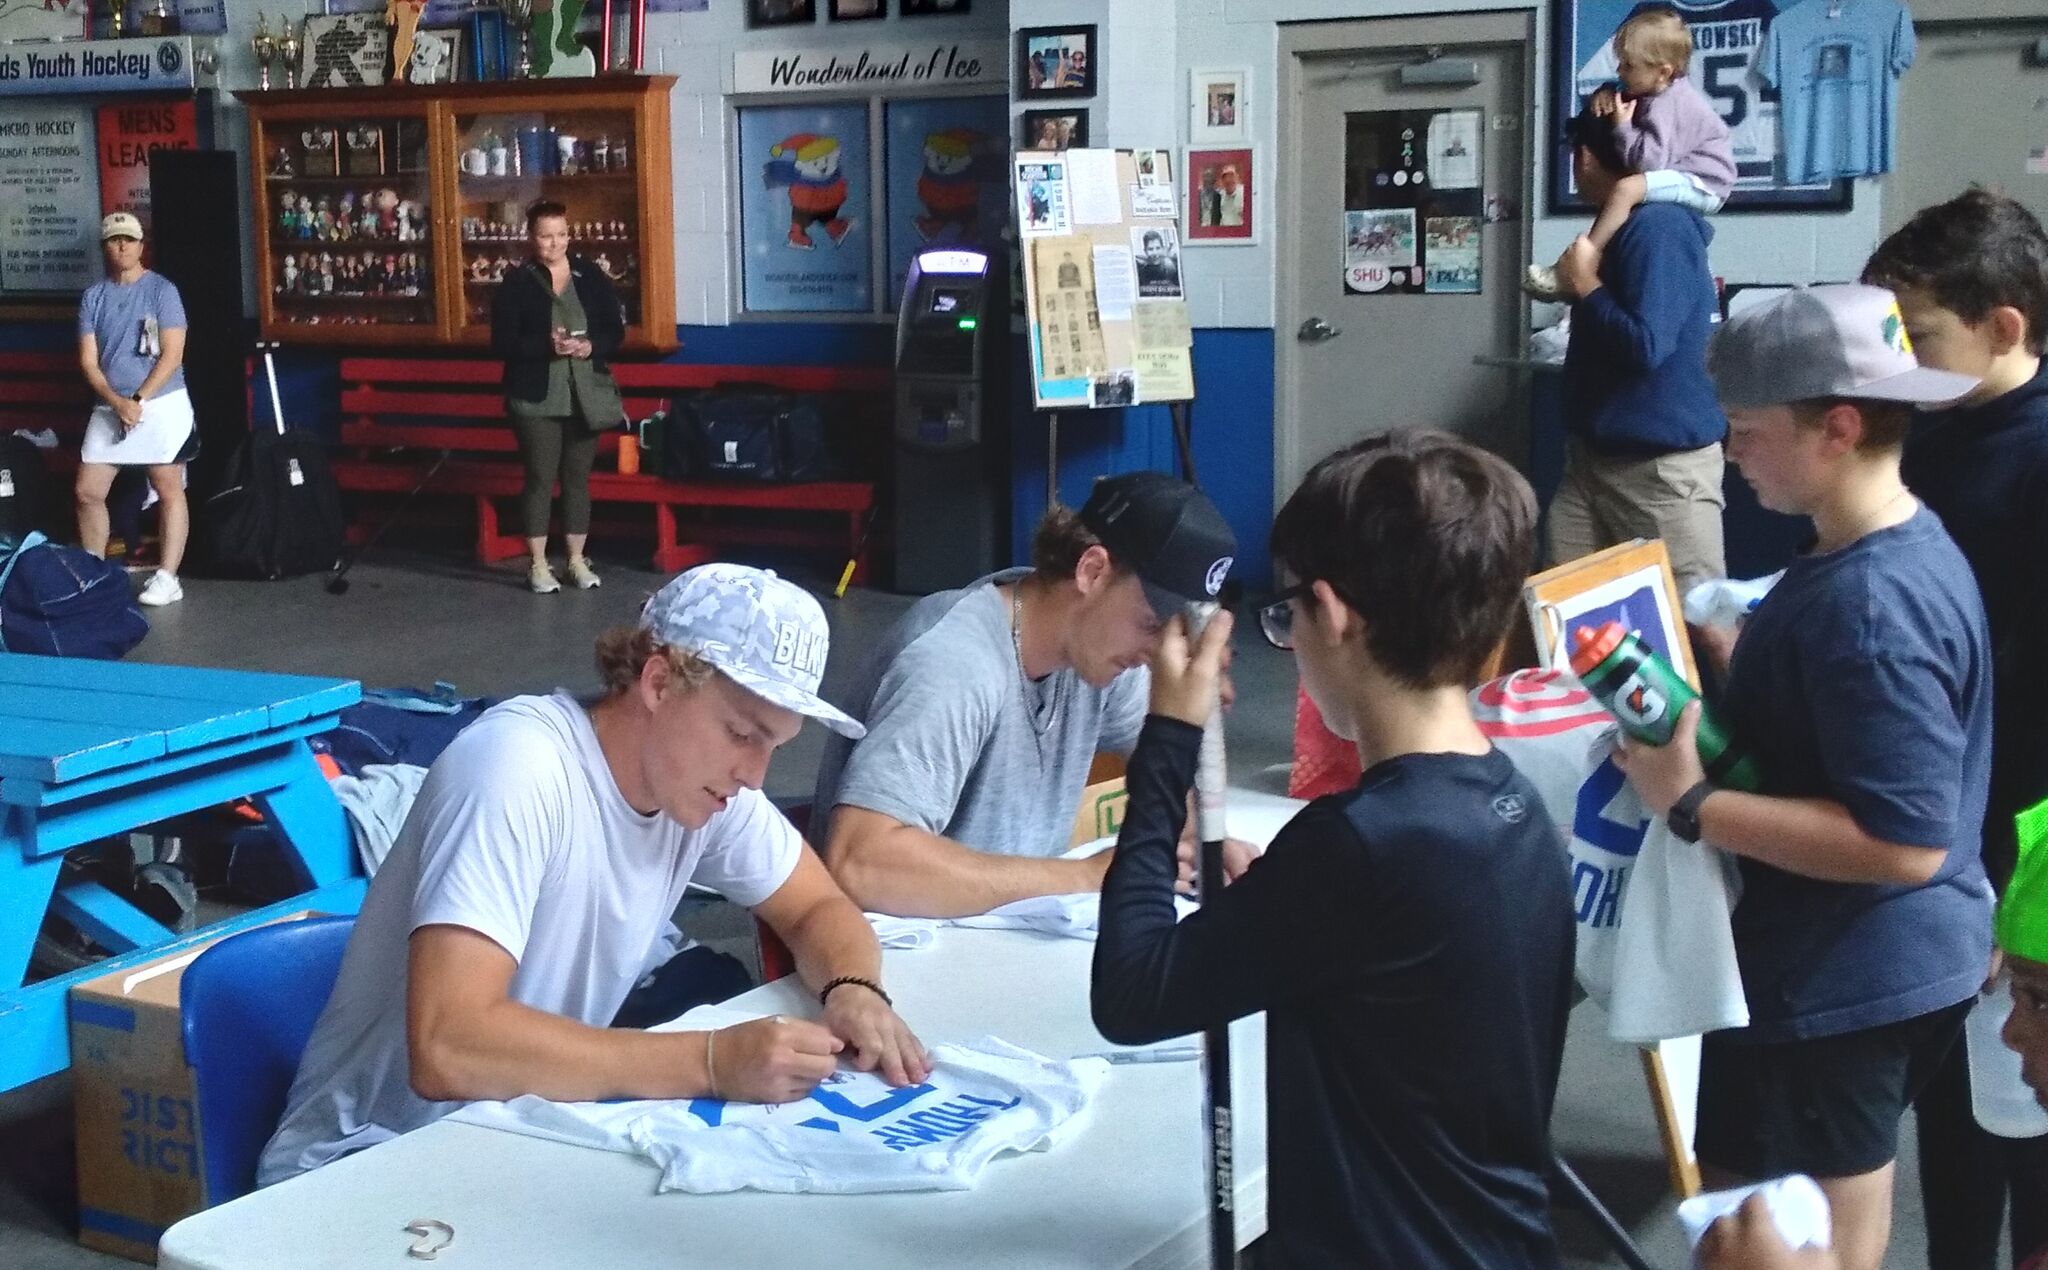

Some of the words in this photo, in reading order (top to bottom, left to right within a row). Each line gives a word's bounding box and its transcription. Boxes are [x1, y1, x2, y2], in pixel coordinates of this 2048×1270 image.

[27, 52, 75, 79] Youth
[82, 50, 150, 80] Hockey
[771, 51, 909, 86] Wonderland
[913, 46, 944, 80] of
[945, 45, 981, 78] Ice
[1703, 53, 1748, 127] 5
[0, 122, 30, 136] MICRO
[35, 121, 76, 136] HOCKEY
[119, 108, 176, 135] MENS
[1353, 268, 1383, 282] SHU
[1614, 672, 1667, 726] G
